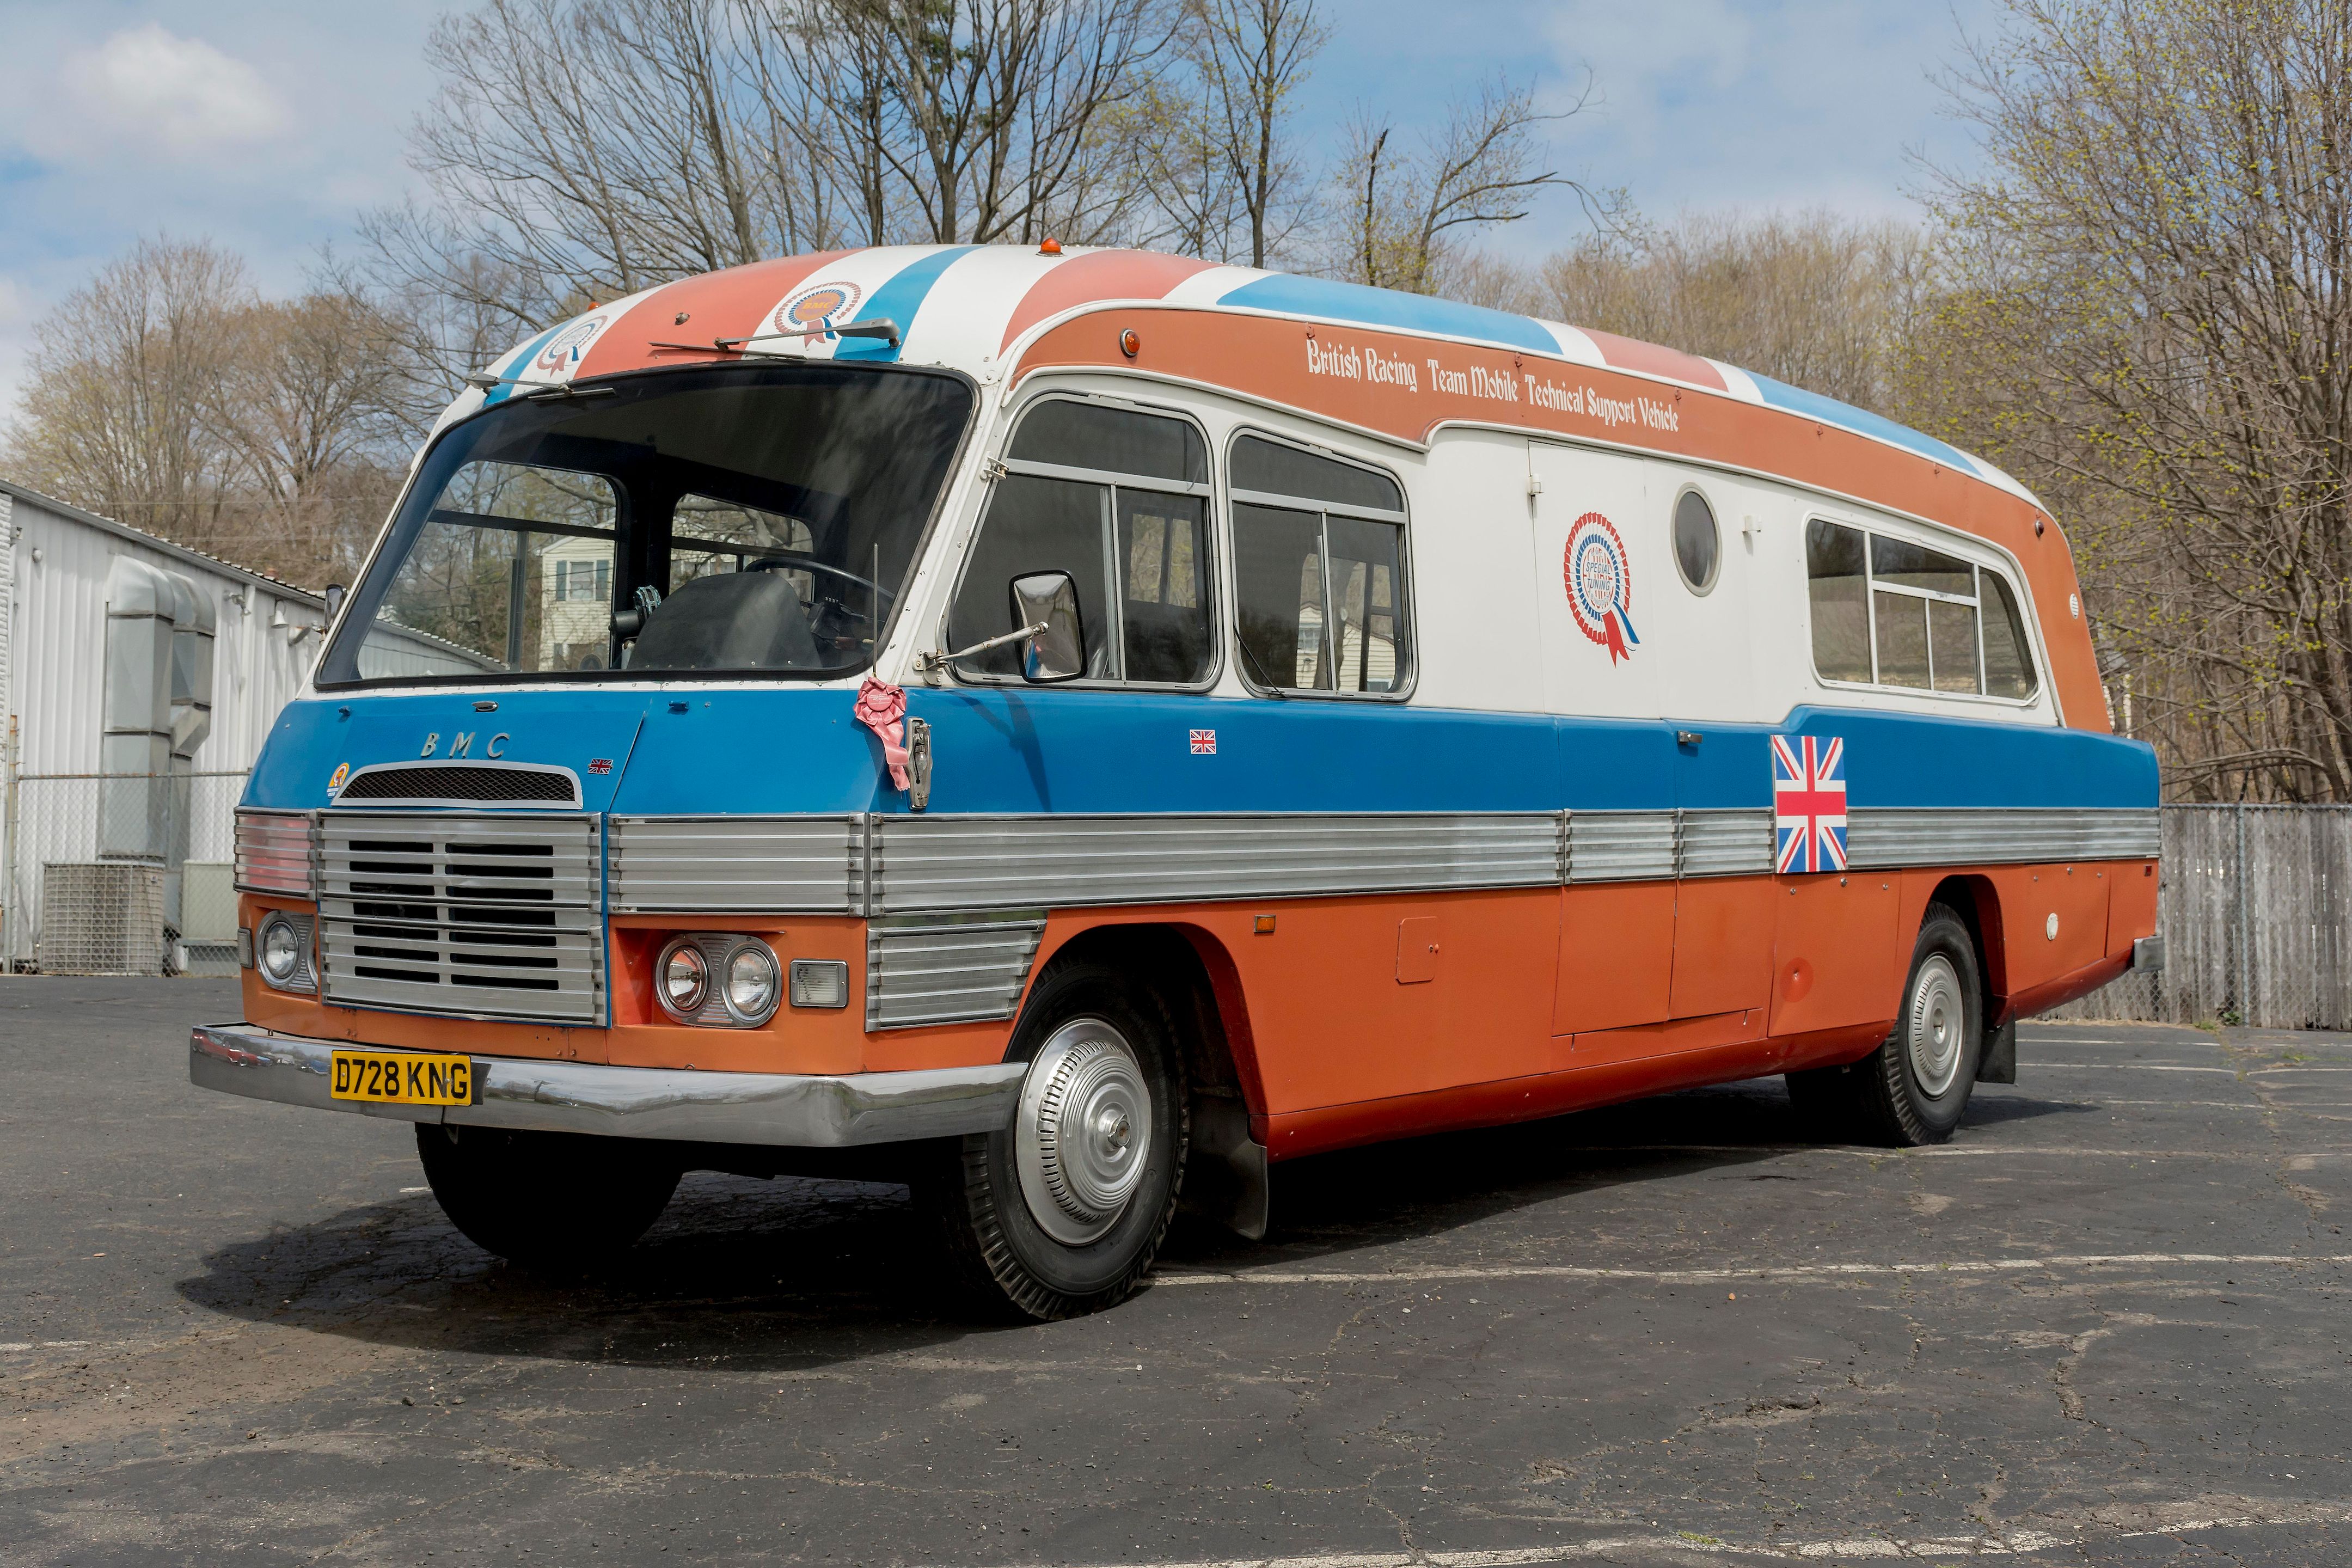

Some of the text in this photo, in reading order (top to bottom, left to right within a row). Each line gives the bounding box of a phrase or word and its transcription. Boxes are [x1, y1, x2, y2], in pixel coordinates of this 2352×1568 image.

[1306, 339, 1679, 432] British Racing Team Mobile Technical Support Vehicle
[1587, 578, 1610, 591] TUNING
[420, 731, 510, 759] BMC
[335, 1057, 467, 1099] D728 KNG
